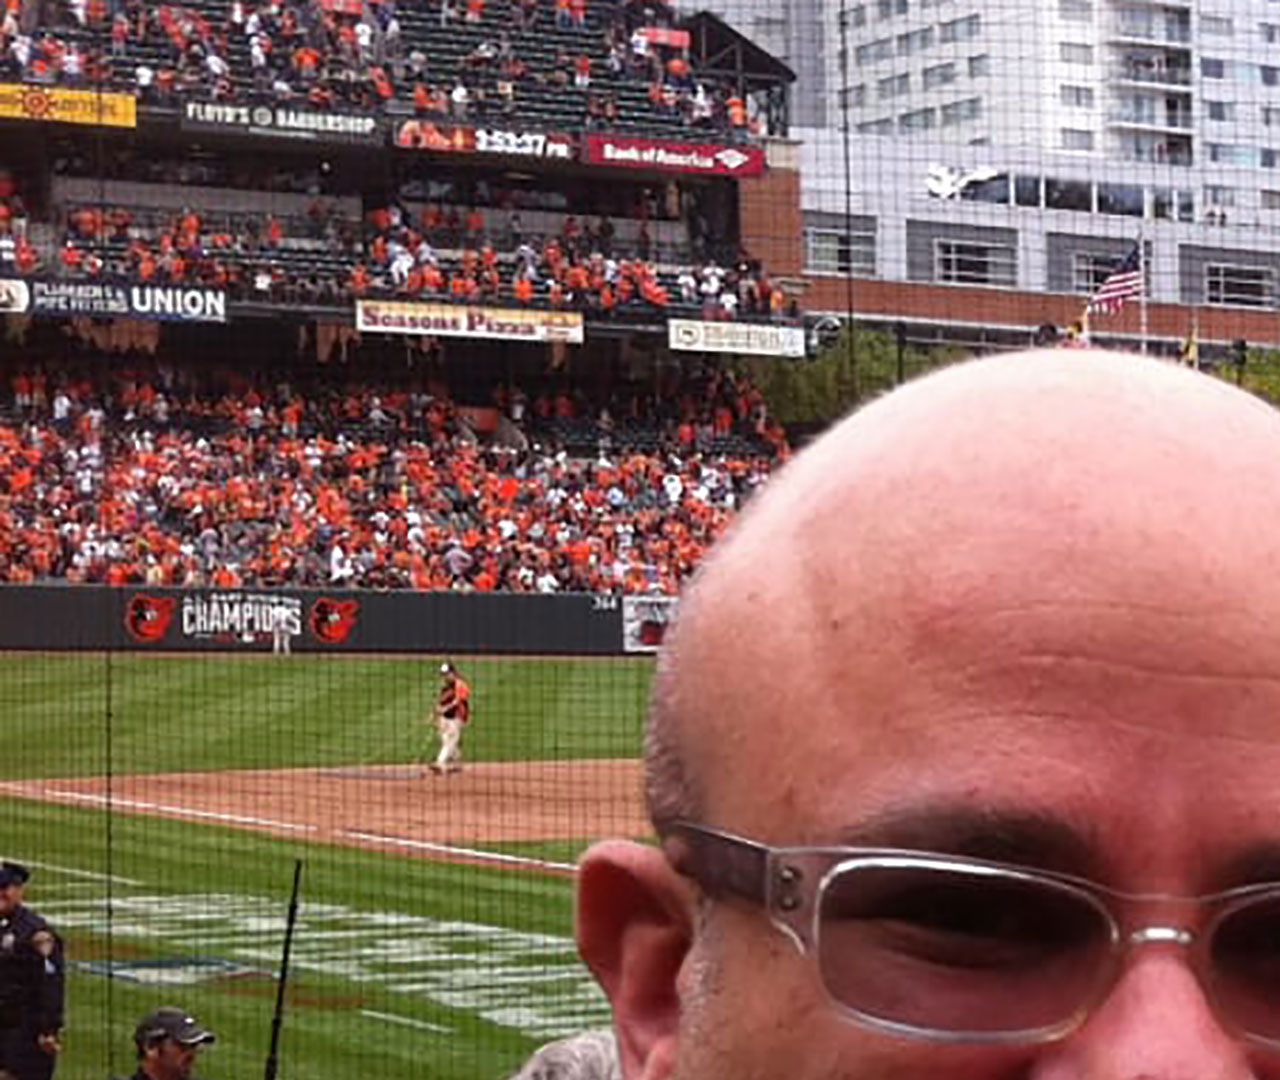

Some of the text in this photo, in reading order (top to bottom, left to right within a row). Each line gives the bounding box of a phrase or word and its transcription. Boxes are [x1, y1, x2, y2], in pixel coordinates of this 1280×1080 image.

[131, 286, 226, 316] UNION
[362, 305, 461, 331] Seasons
[466, 309, 536, 335] Pizza
[183, 602, 302, 635] CHAMPIOS
